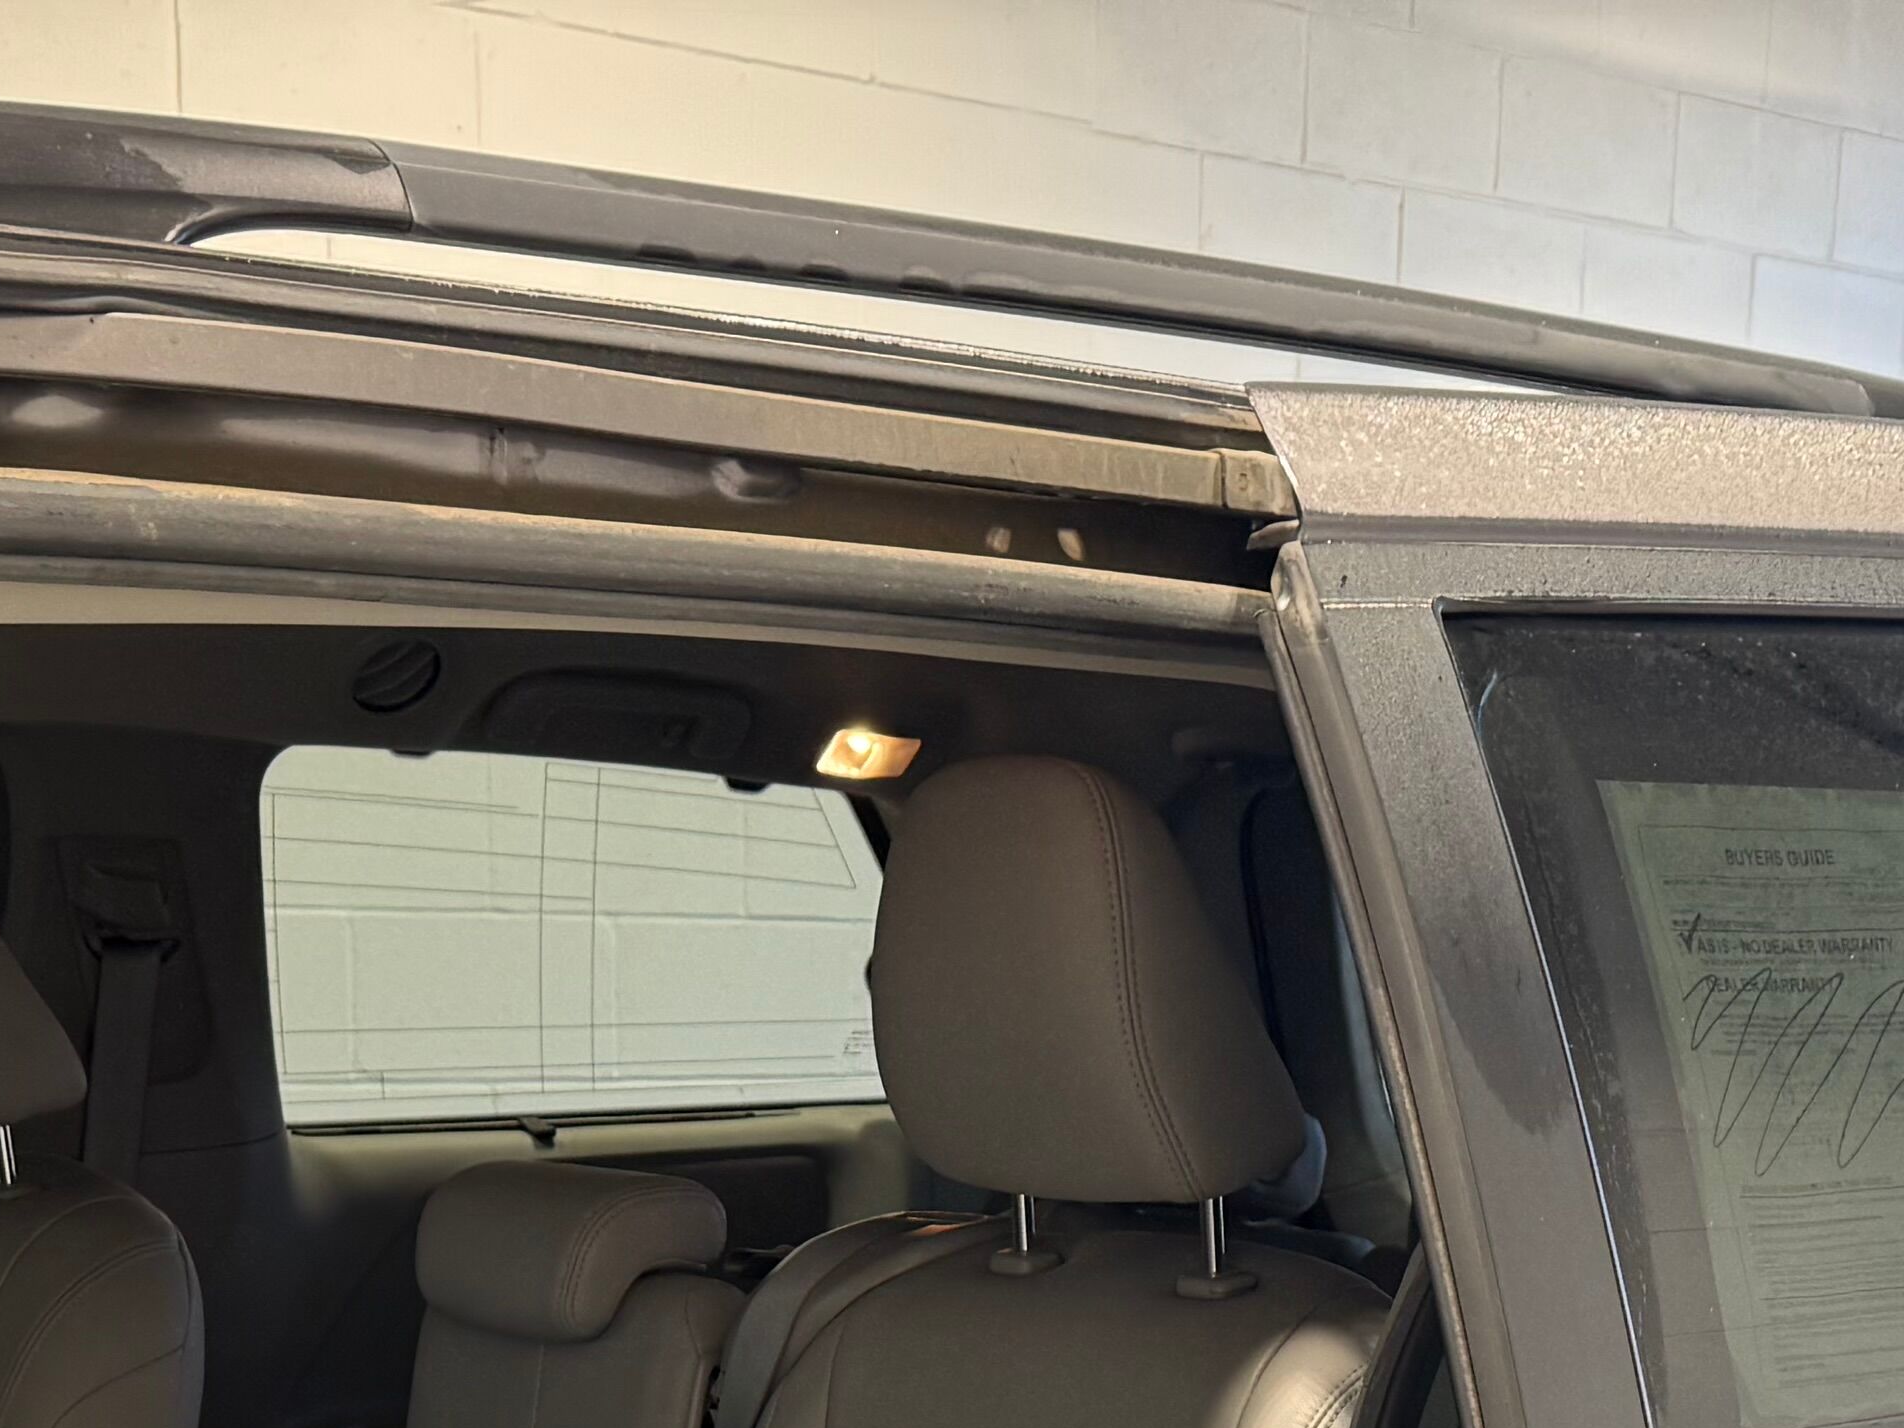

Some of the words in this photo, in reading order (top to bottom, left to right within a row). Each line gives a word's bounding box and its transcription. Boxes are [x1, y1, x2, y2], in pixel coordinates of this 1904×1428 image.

[1725, 849, 1783, 866] BUYERS
[1787, 849, 1835, 866] GUIDE
[1740, 938, 1761, 955] NO
[1762, 938, 1815, 955] DEALER
[1818, 936, 1893, 955] WARRANTY
